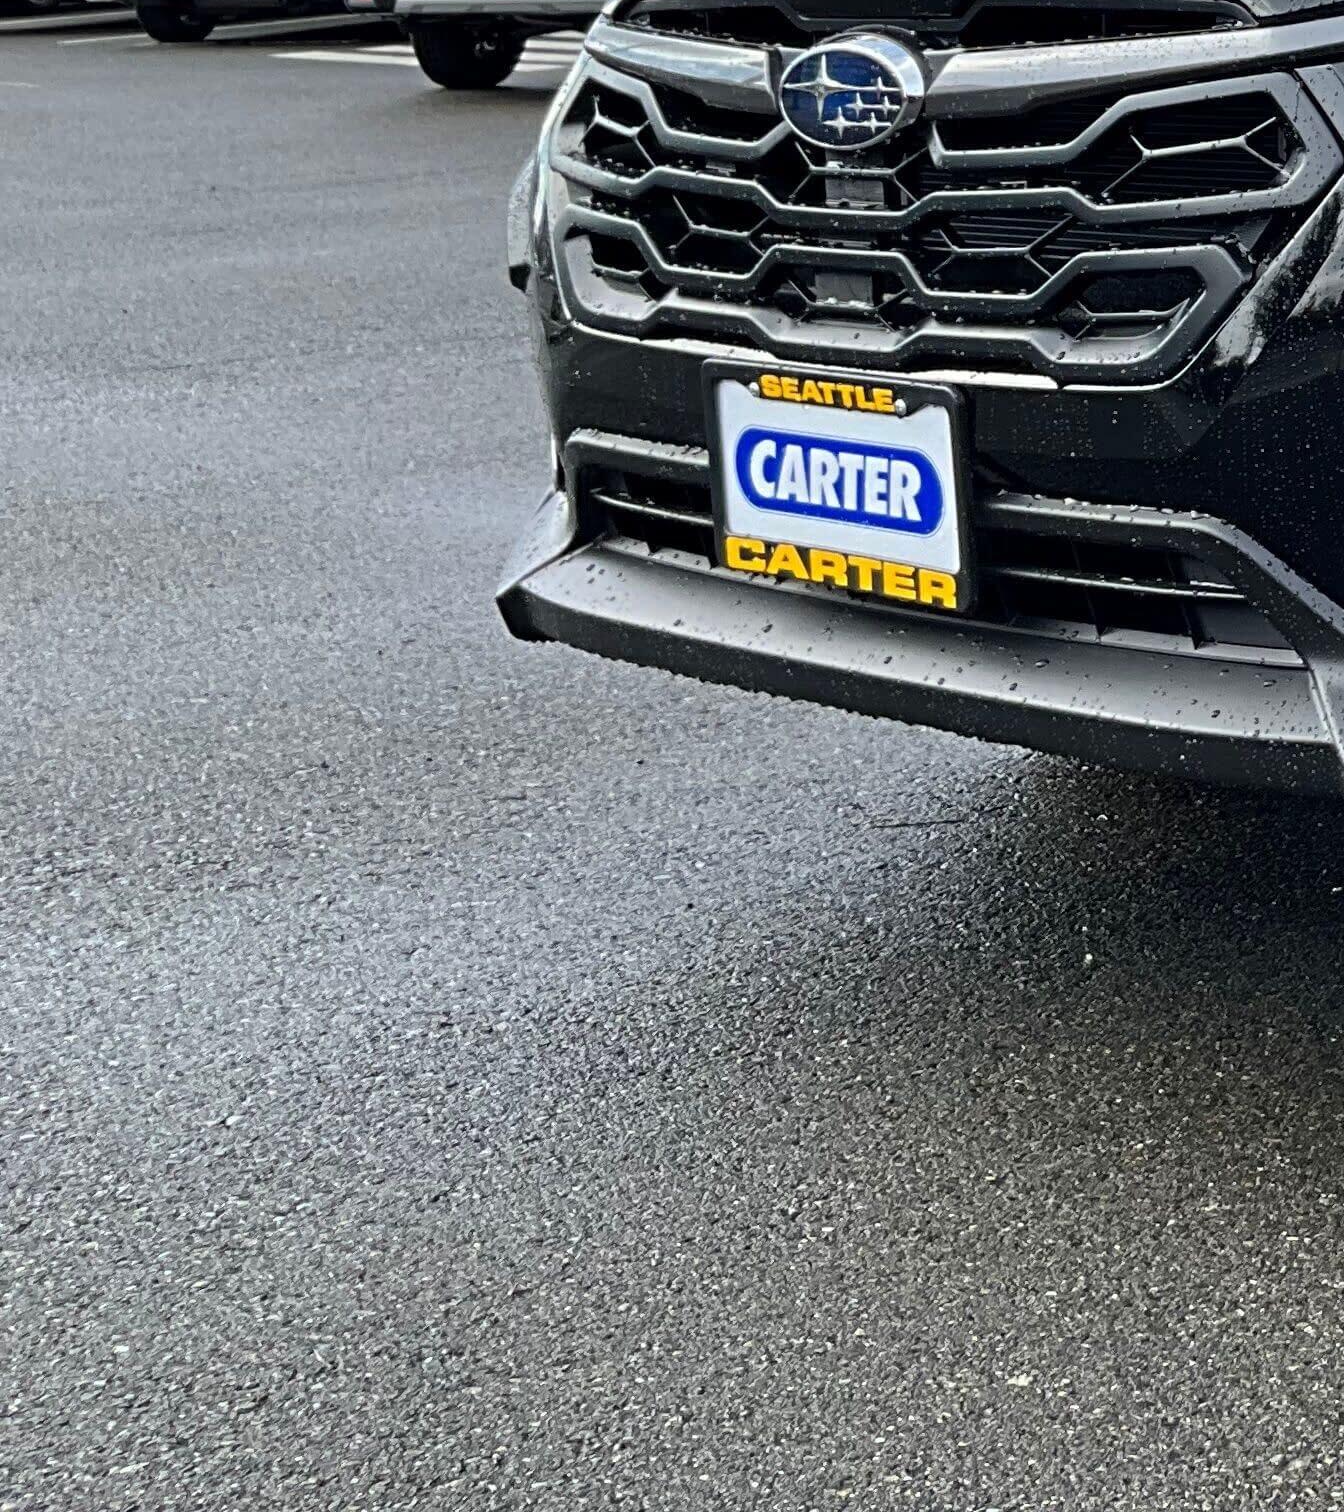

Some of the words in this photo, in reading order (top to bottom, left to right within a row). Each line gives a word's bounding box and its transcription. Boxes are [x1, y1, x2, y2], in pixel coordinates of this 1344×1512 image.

[759, 374, 896, 414] SEATTLE
[751, 439, 922, 522] CARTER
[725, 536, 957, 609] CARTER
